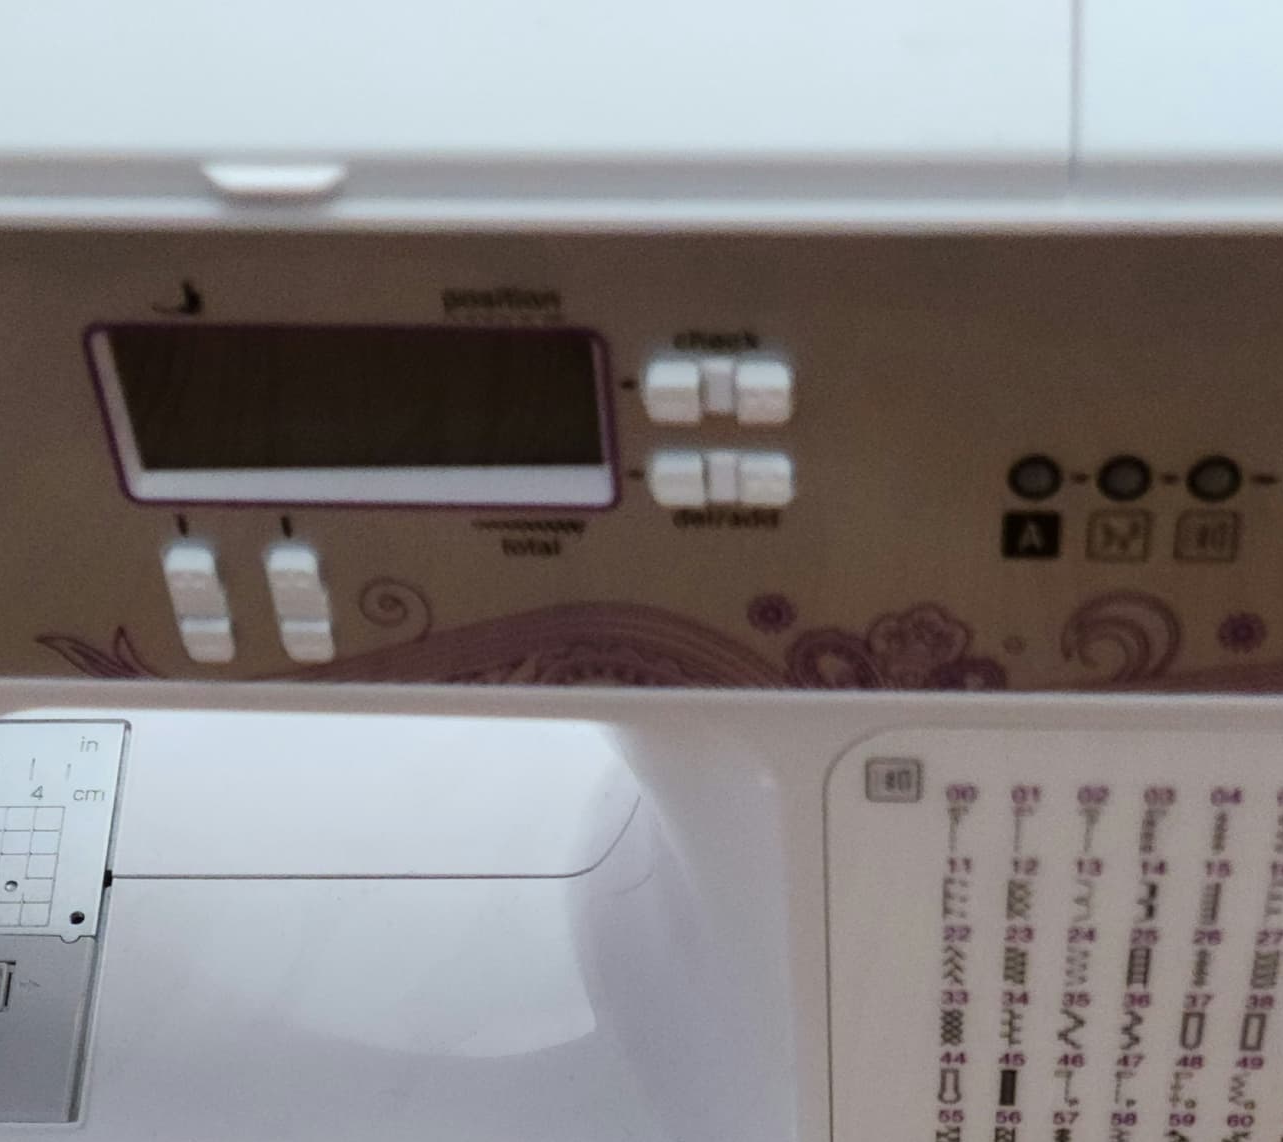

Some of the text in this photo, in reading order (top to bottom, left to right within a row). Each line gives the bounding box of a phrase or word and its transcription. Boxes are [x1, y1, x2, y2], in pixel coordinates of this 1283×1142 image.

[80, 736, 99, 752] in
[30, 785, 44, 800] 4
[73, 788, 105, 801] cm
[939, 1052, 967, 1066] 44
[998, 1053, 1026, 1067] 45
[1057, 1054, 1085, 1068] 46
[1116, 1054, 1144, 1069] 47
[1175, 1055, 1204, 1069] 48
[1235, 1056, 1264, 1070] 49
[938, 1110, 964, 1123] 55
[995, 1111, 1022, 1124] 56
[1052, 1112, 1079, 1125] 57
[1110, 1112, 1137, 1126] 58
[1168, 1113, 1196, 1127] 59
[1226, 1114, 1254, 1128] 60
